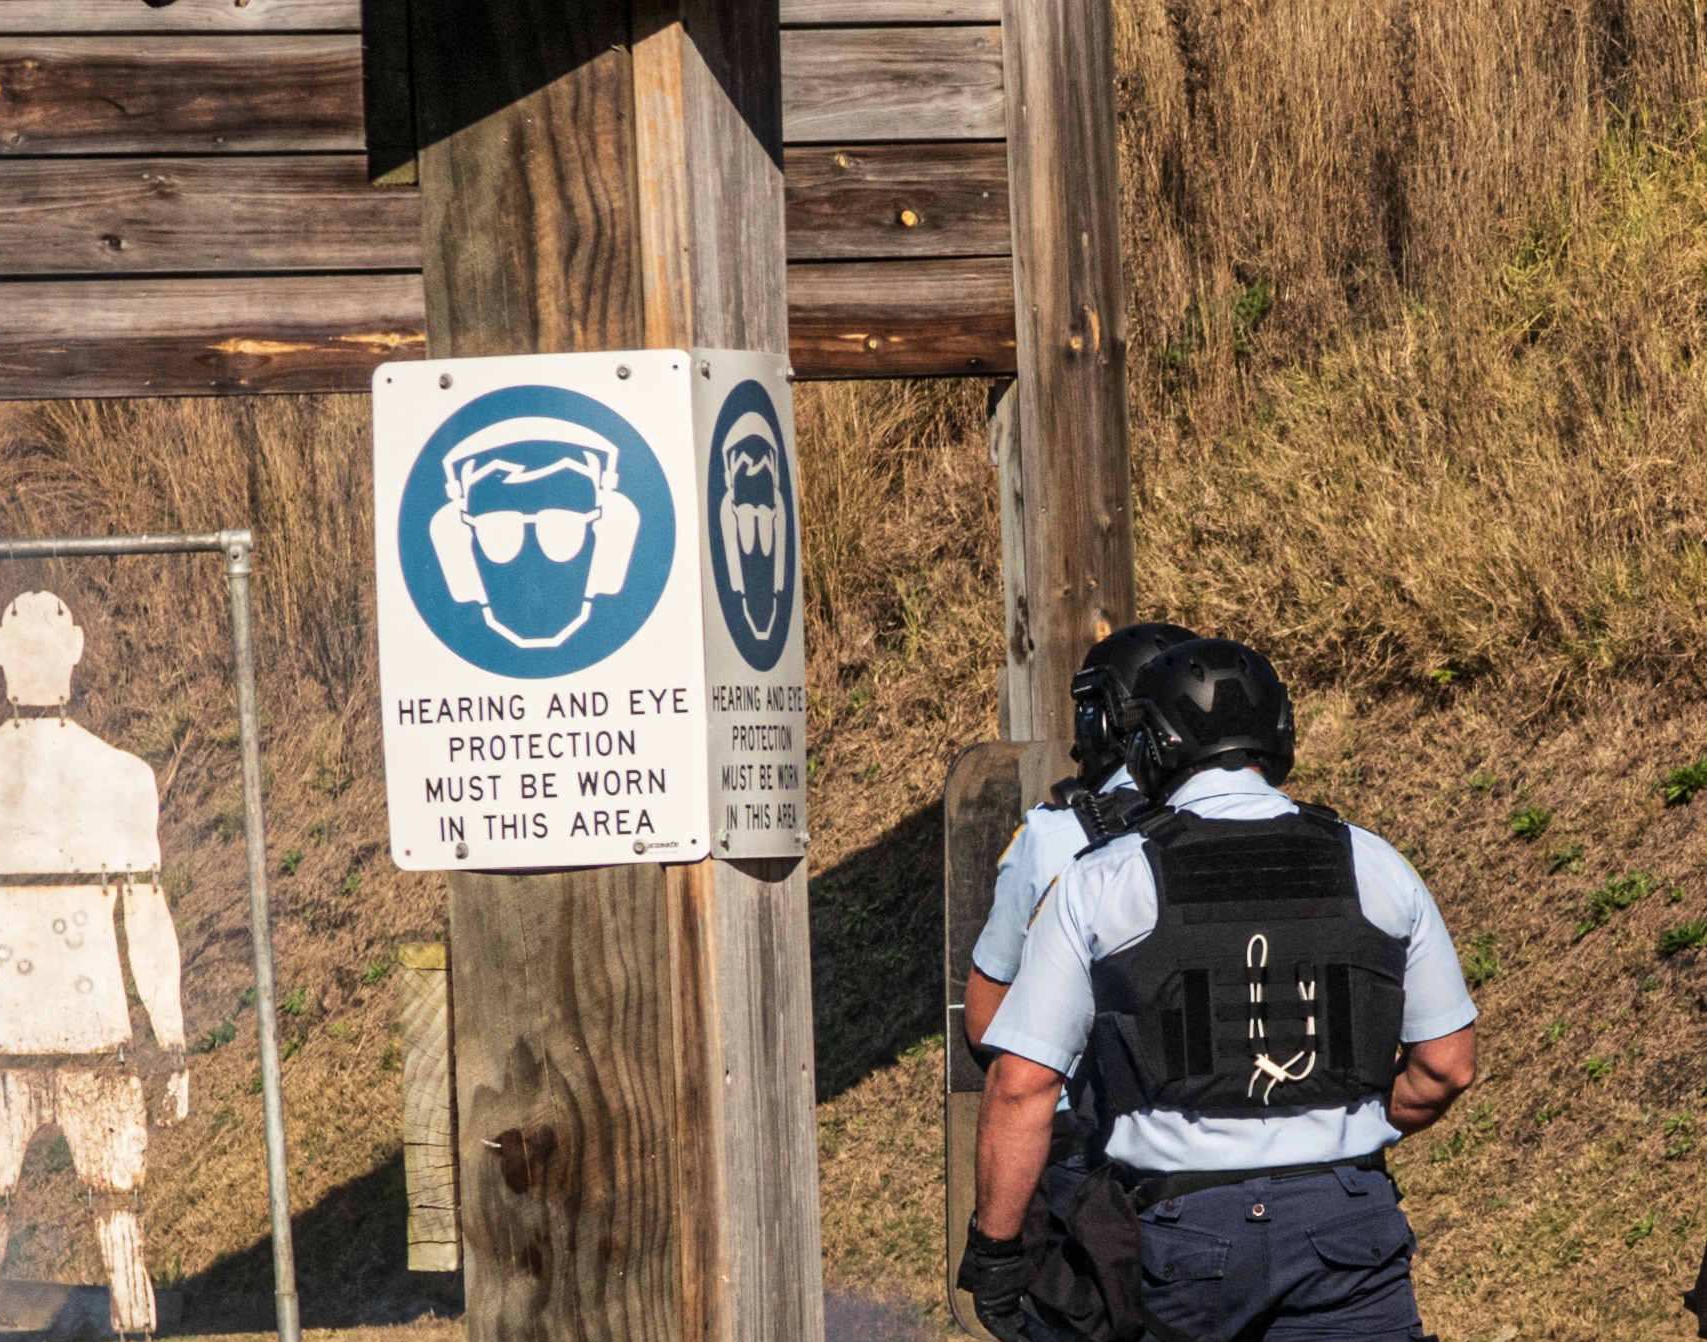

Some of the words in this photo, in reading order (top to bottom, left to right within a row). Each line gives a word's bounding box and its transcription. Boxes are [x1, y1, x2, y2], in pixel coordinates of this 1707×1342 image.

[398, 695, 525, 725] HEARING
[547, 692, 609, 719] AND
[629, 688, 689, 715] EYE
[712, 686, 760, 712] HEARING
[766, 686, 784, 712] AND
[788, 686, 803, 712] EYE
[449, 730, 635, 762] PROTECTION
[732, 725, 792, 751] PROTECTION
[425, 775, 501, 803] MUST
[520, 773, 558, 799] BE
[577, 769, 666, 797] WORN
[722, 765, 753, 790] MUST
[760, 765, 773, 790] BE
[777, 764, 799, 790] WORN
[440, 817, 465, 842] IN
[483, 812, 548, 840] THIS
[570, 809, 655, 837] AREA
[726, 804, 738, 830] IN
[745, 804, 771, 830] THIS
[777, 804, 797, 830] AREA
